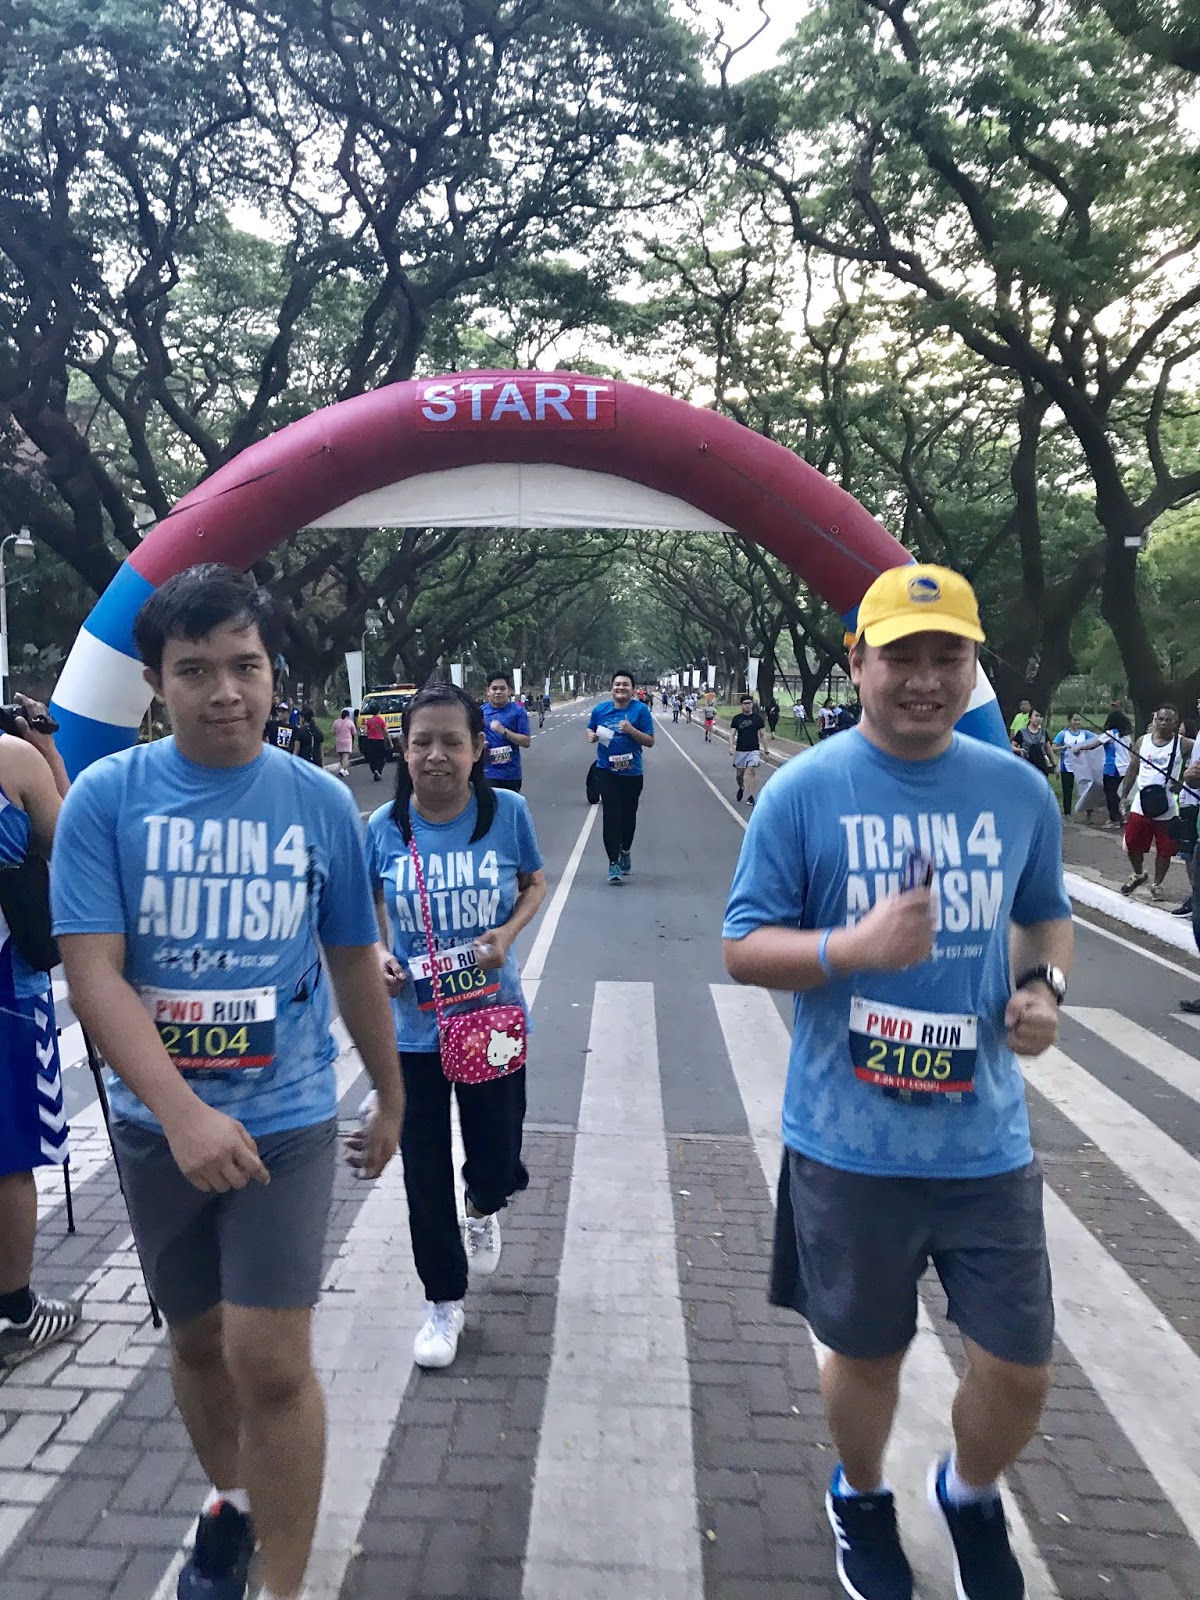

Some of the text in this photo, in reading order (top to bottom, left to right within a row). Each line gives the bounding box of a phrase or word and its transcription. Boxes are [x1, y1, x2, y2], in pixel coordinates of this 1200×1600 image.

[421, 382, 609, 422] START
[143, 815, 308, 877] TRAIN 4
[839, 811, 1003, 871] TRAIN 4
[395, 849, 499, 892] TRAIN 4
[138, 875, 307, 941] AUTISM
[395, 888, 500, 933] AUTISM
[457, 949, 477, 968] RU
[429, 967, 487, 999] 2103
[155, 999, 257, 1021] PWD RUN
[866, 1012, 961, 1047] PWD RUN
[160, 1025, 250, 1055] 2104
[866, 1039, 953, 1080] 2105
